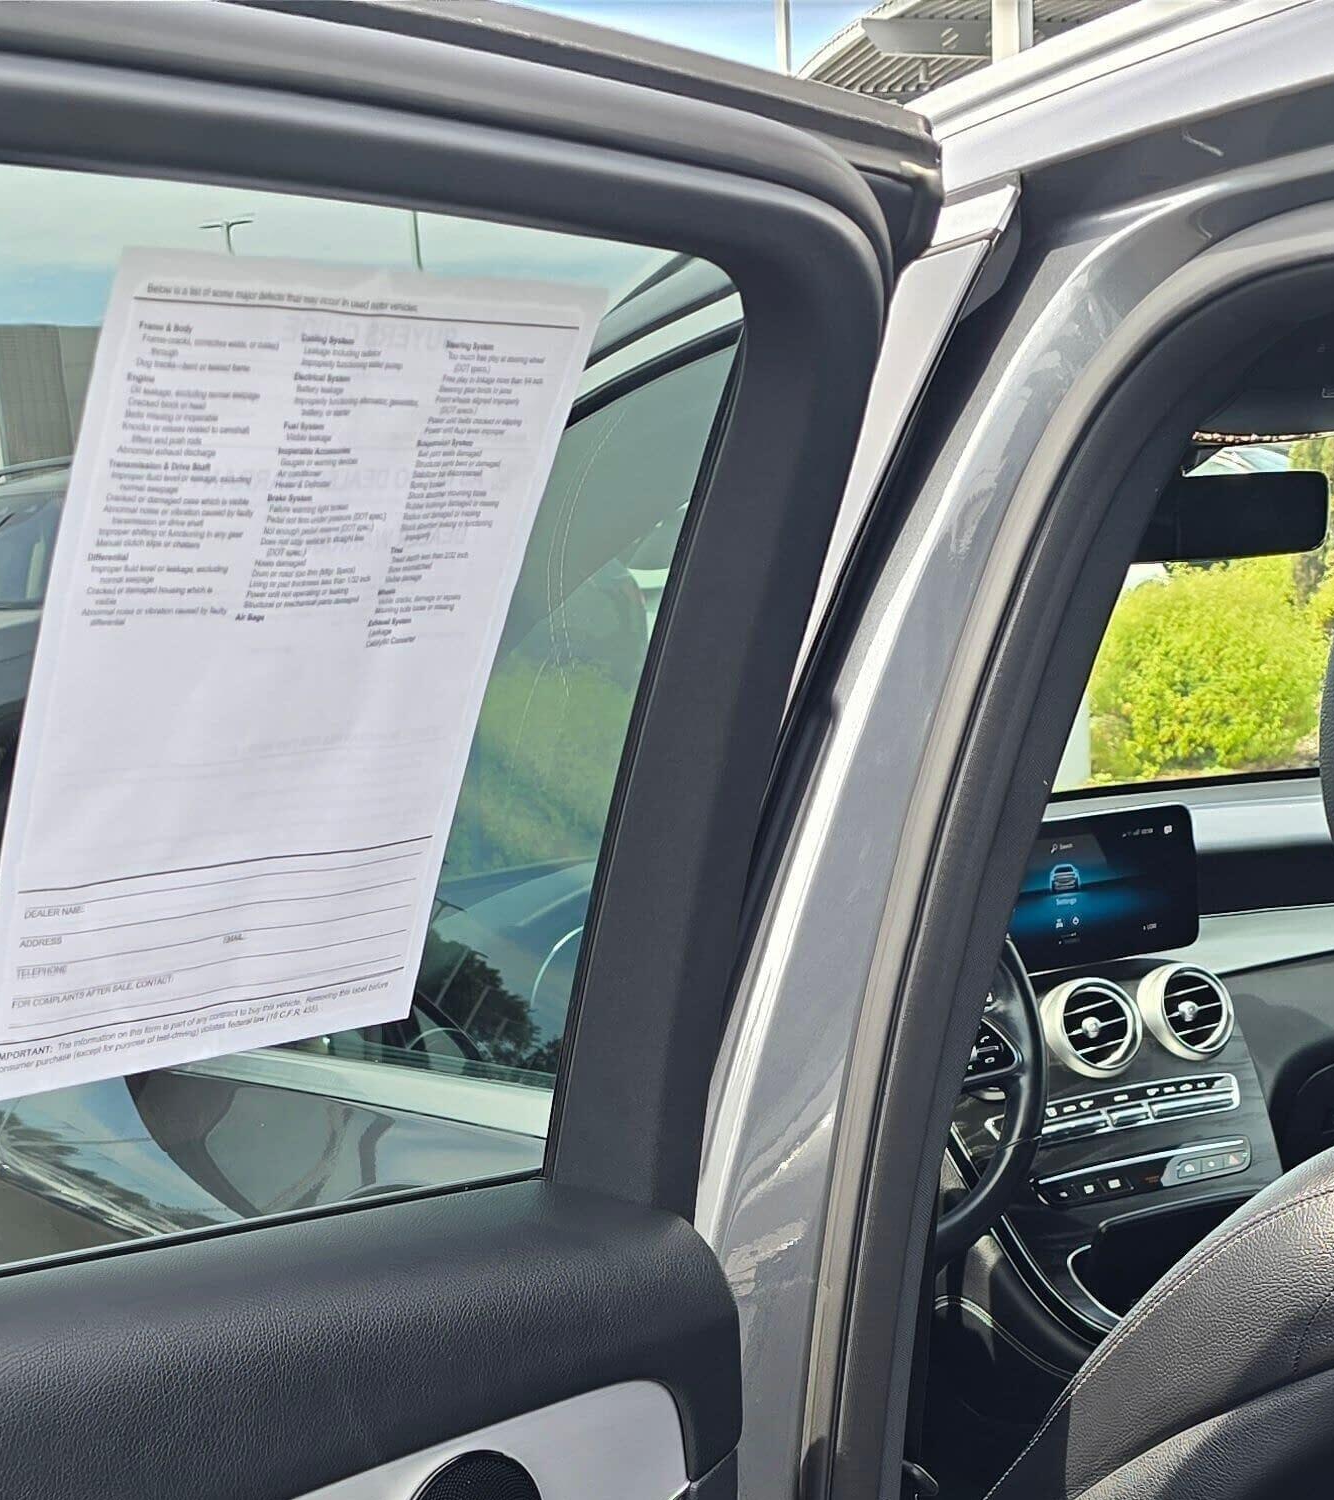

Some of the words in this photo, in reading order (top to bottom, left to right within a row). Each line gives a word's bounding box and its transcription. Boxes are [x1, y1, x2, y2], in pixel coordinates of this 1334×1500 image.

[147, 283, 172, 295] Below
[189, 286, 201, 297] list
[211, 289, 233, 299] some
[234, 291, 255, 302] major
[173, 323, 193, 334] Body
[127, 372, 155, 384] Engine
[170, 461, 190, 470] Drive
[267, 493, 287, 502] Brake
[98, 527, 130, 538] Improper
[235, 613, 245, 621] Air
[24, 908, 59, 918] DEALER
[19, 937, 62, 947] ADDRESS
[16, 965, 67, 977] TELEPHONE
[12, 998, 31, 1008] FOR
[32, 991, 84, 1006] COMPLAINTS
[85, 985, 111, 996] AFTER
[58, 1039, 72, 1048] The
[73, 1031, 116, 1046] information
[143, 1024, 161, 1034] form
[162, 1022, 169, 1031] is
[170, 1020, 185, 1031] part
[186, 1018, 194, 1027] of
[195, 1017, 207, 1027] any
[239, 1006, 247, 1015] to
[248, 1004, 261, 1015] buy
[368, 981, 388, 991] before
[35, 1051, 71, 1066] purchase
[102, 1044, 113, 1053] for
[146, 1036, 154, 1045] of
[227, 1017, 252, 1027] federal
[253, 1013, 265, 1022] law
